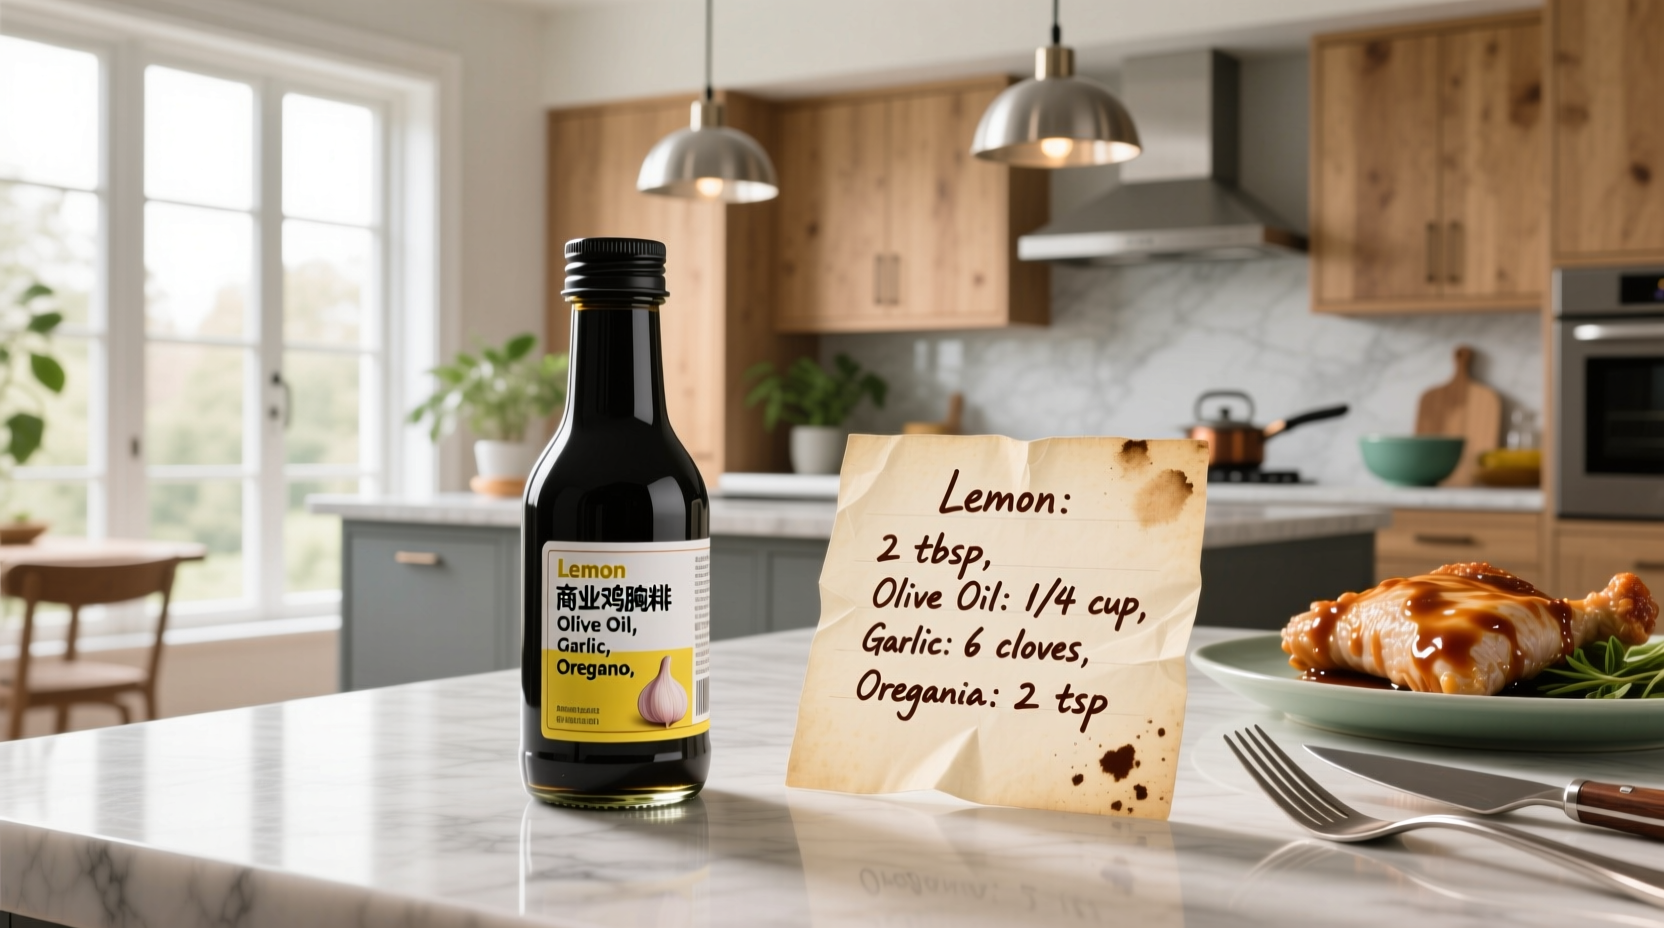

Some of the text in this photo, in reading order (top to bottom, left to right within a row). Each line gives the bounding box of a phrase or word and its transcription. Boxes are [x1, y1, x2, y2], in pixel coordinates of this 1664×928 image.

[938, 468, 1071, 515] Lemon:
[557, 557, 626, 580] Lemon
[876, 531, 991, 583] 2 tbsp,
[556, 615, 637, 637] Olive Oil,
[872, 576, 1146, 632] Olive Oil: 1/4 cup,
[557, 637, 611, 658] Garlic,
[861, 621, 1089, 669] Garlic: 6 cloves,
[556, 659, 635, 681] Oregano,
[856, 668, 1109, 734] Oregania: 2 tsp
